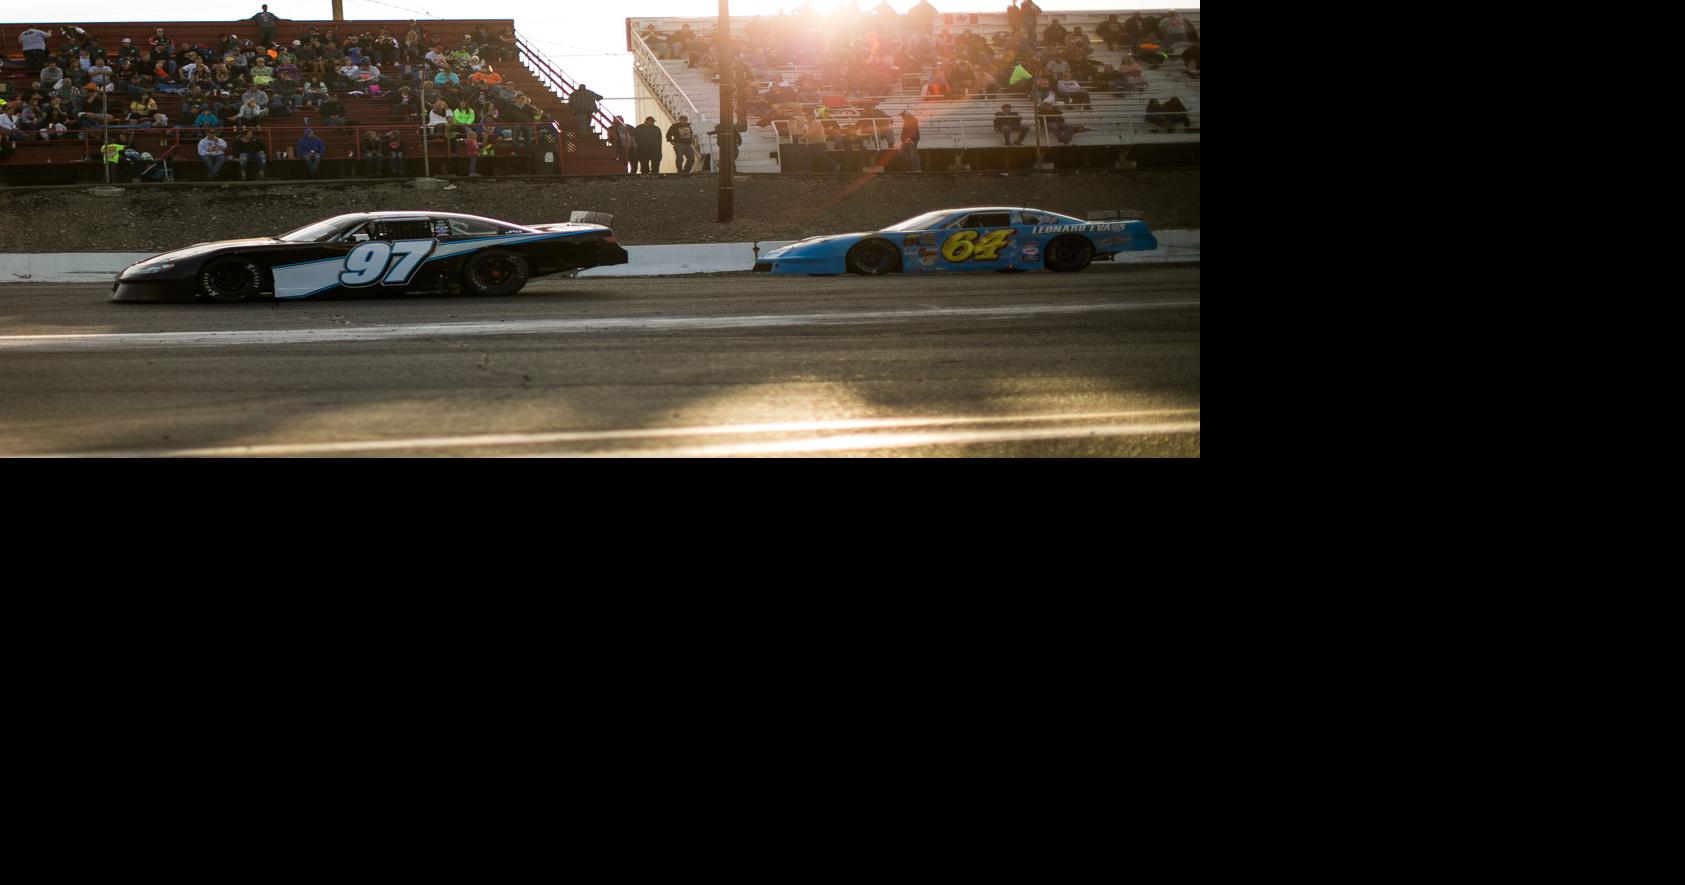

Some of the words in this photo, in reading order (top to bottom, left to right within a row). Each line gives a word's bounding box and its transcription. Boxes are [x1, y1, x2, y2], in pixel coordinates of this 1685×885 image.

[941, 229, 1016, 263] 64
[1032, 223, 1088, 235] LEONARD
[338, 238, 438, 288] 97
